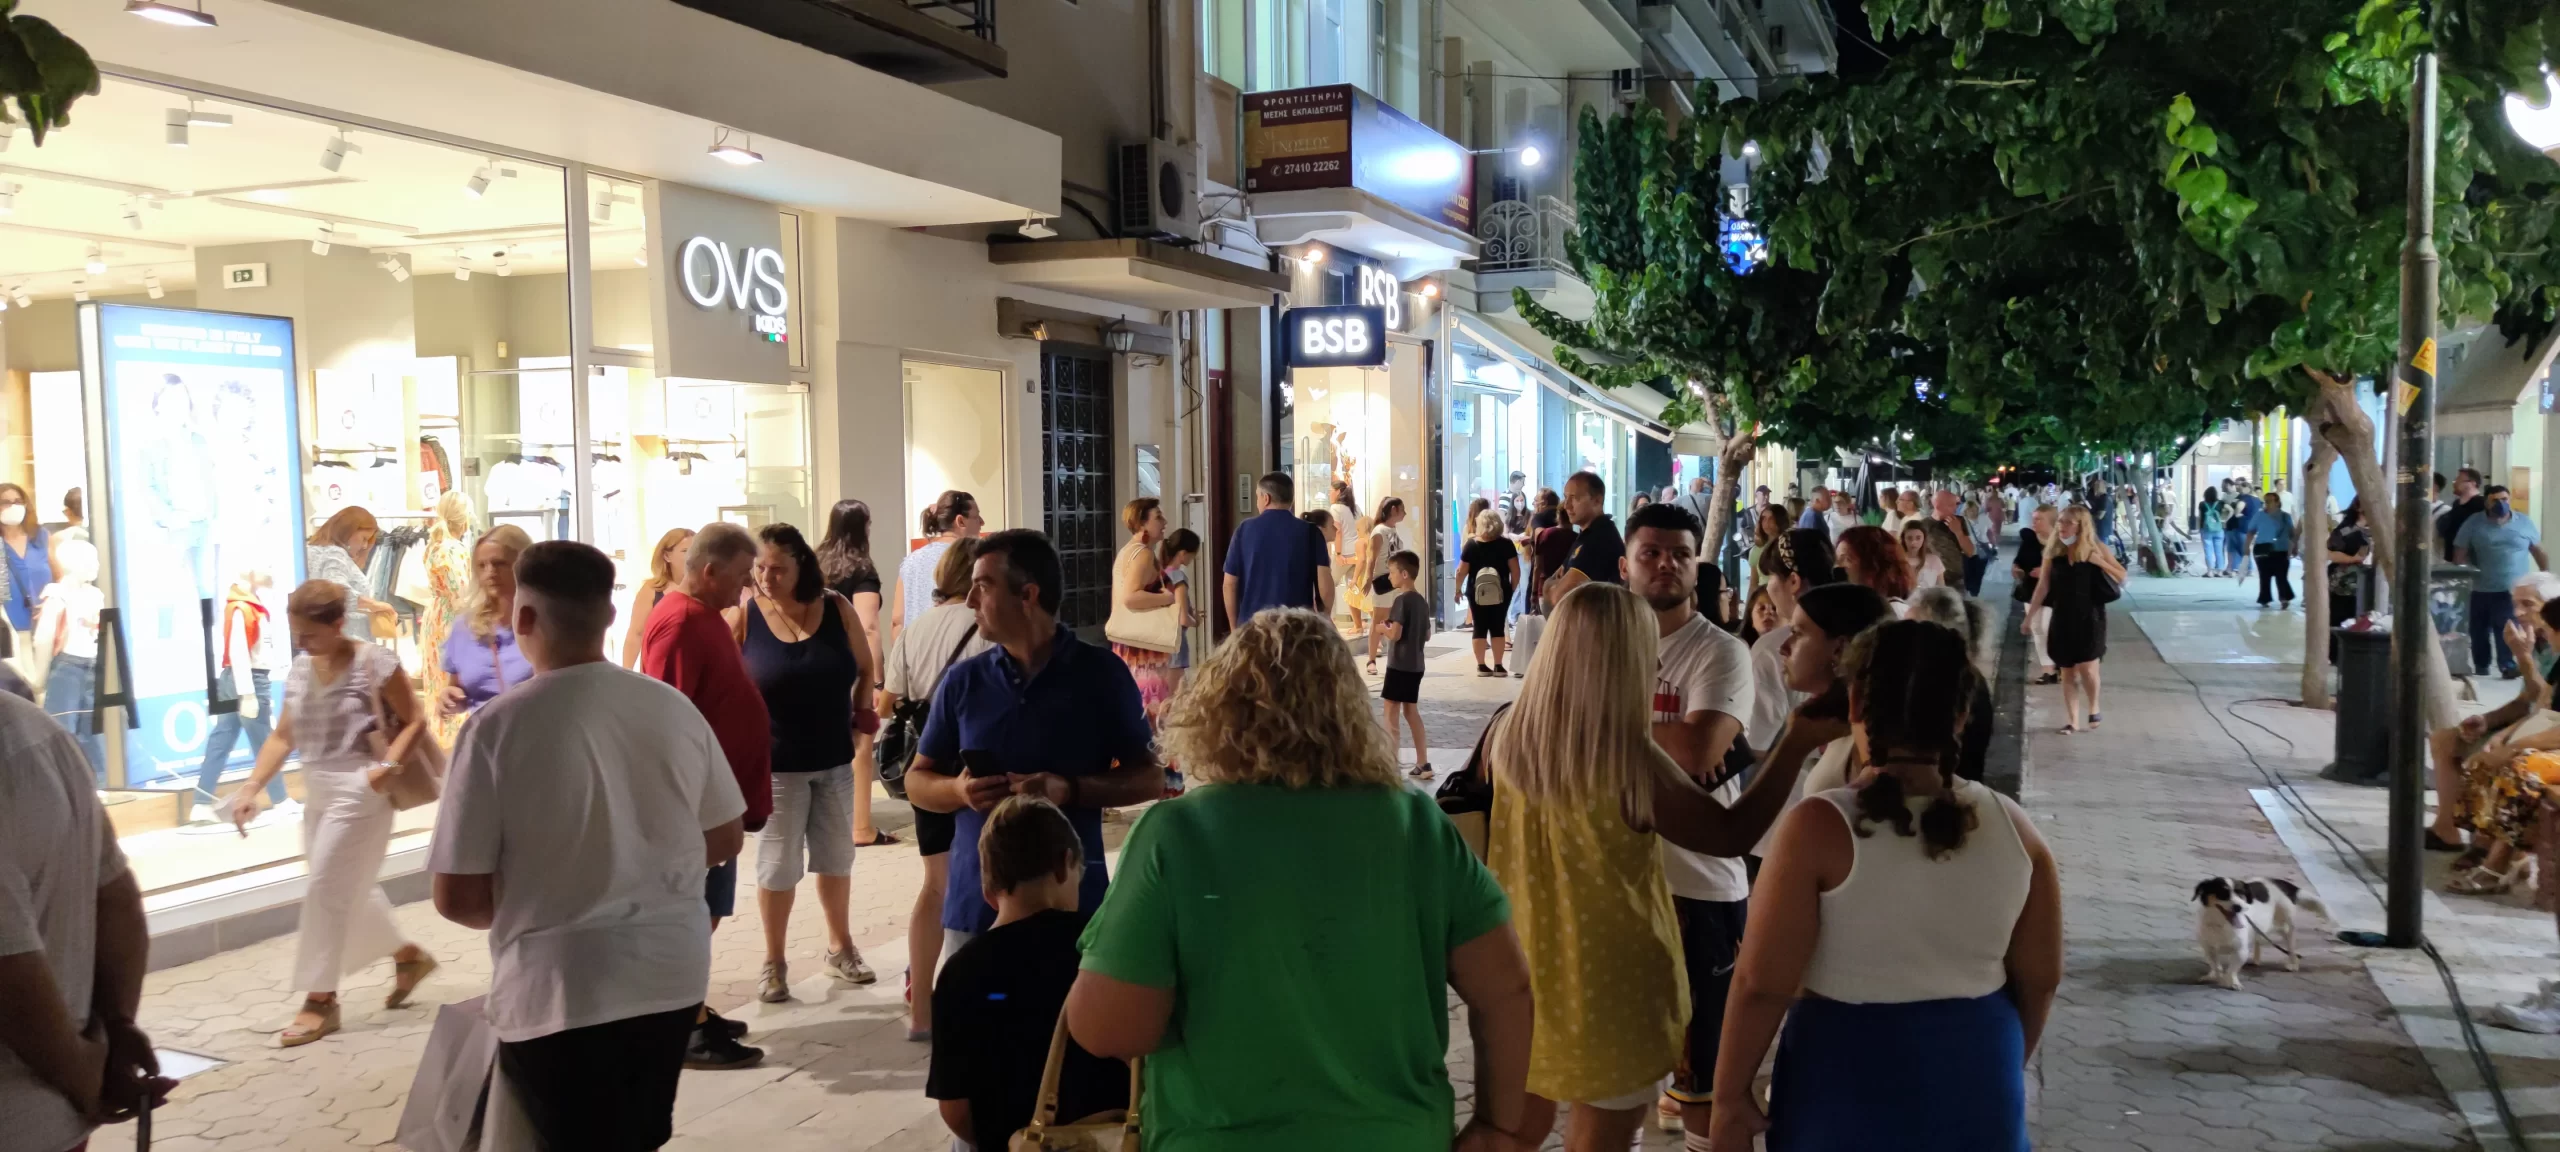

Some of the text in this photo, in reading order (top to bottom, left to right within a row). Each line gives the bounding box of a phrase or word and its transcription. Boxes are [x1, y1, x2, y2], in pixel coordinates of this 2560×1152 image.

[1263, 91, 1344, 106] ΦΡΟΝΤΙΣΤΗΡΙΑ
[1263, 104, 1344, 119] ΜΕΣΗΣ ΕΚΠΑΙΔΕΥΣΗΣ
[1284, 160, 1340, 174] 27410 22262
[683, 236, 788, 315] OVS
[756, 314, 787, 334] KIDS
[1304, 318, 1368, 354] BSB
